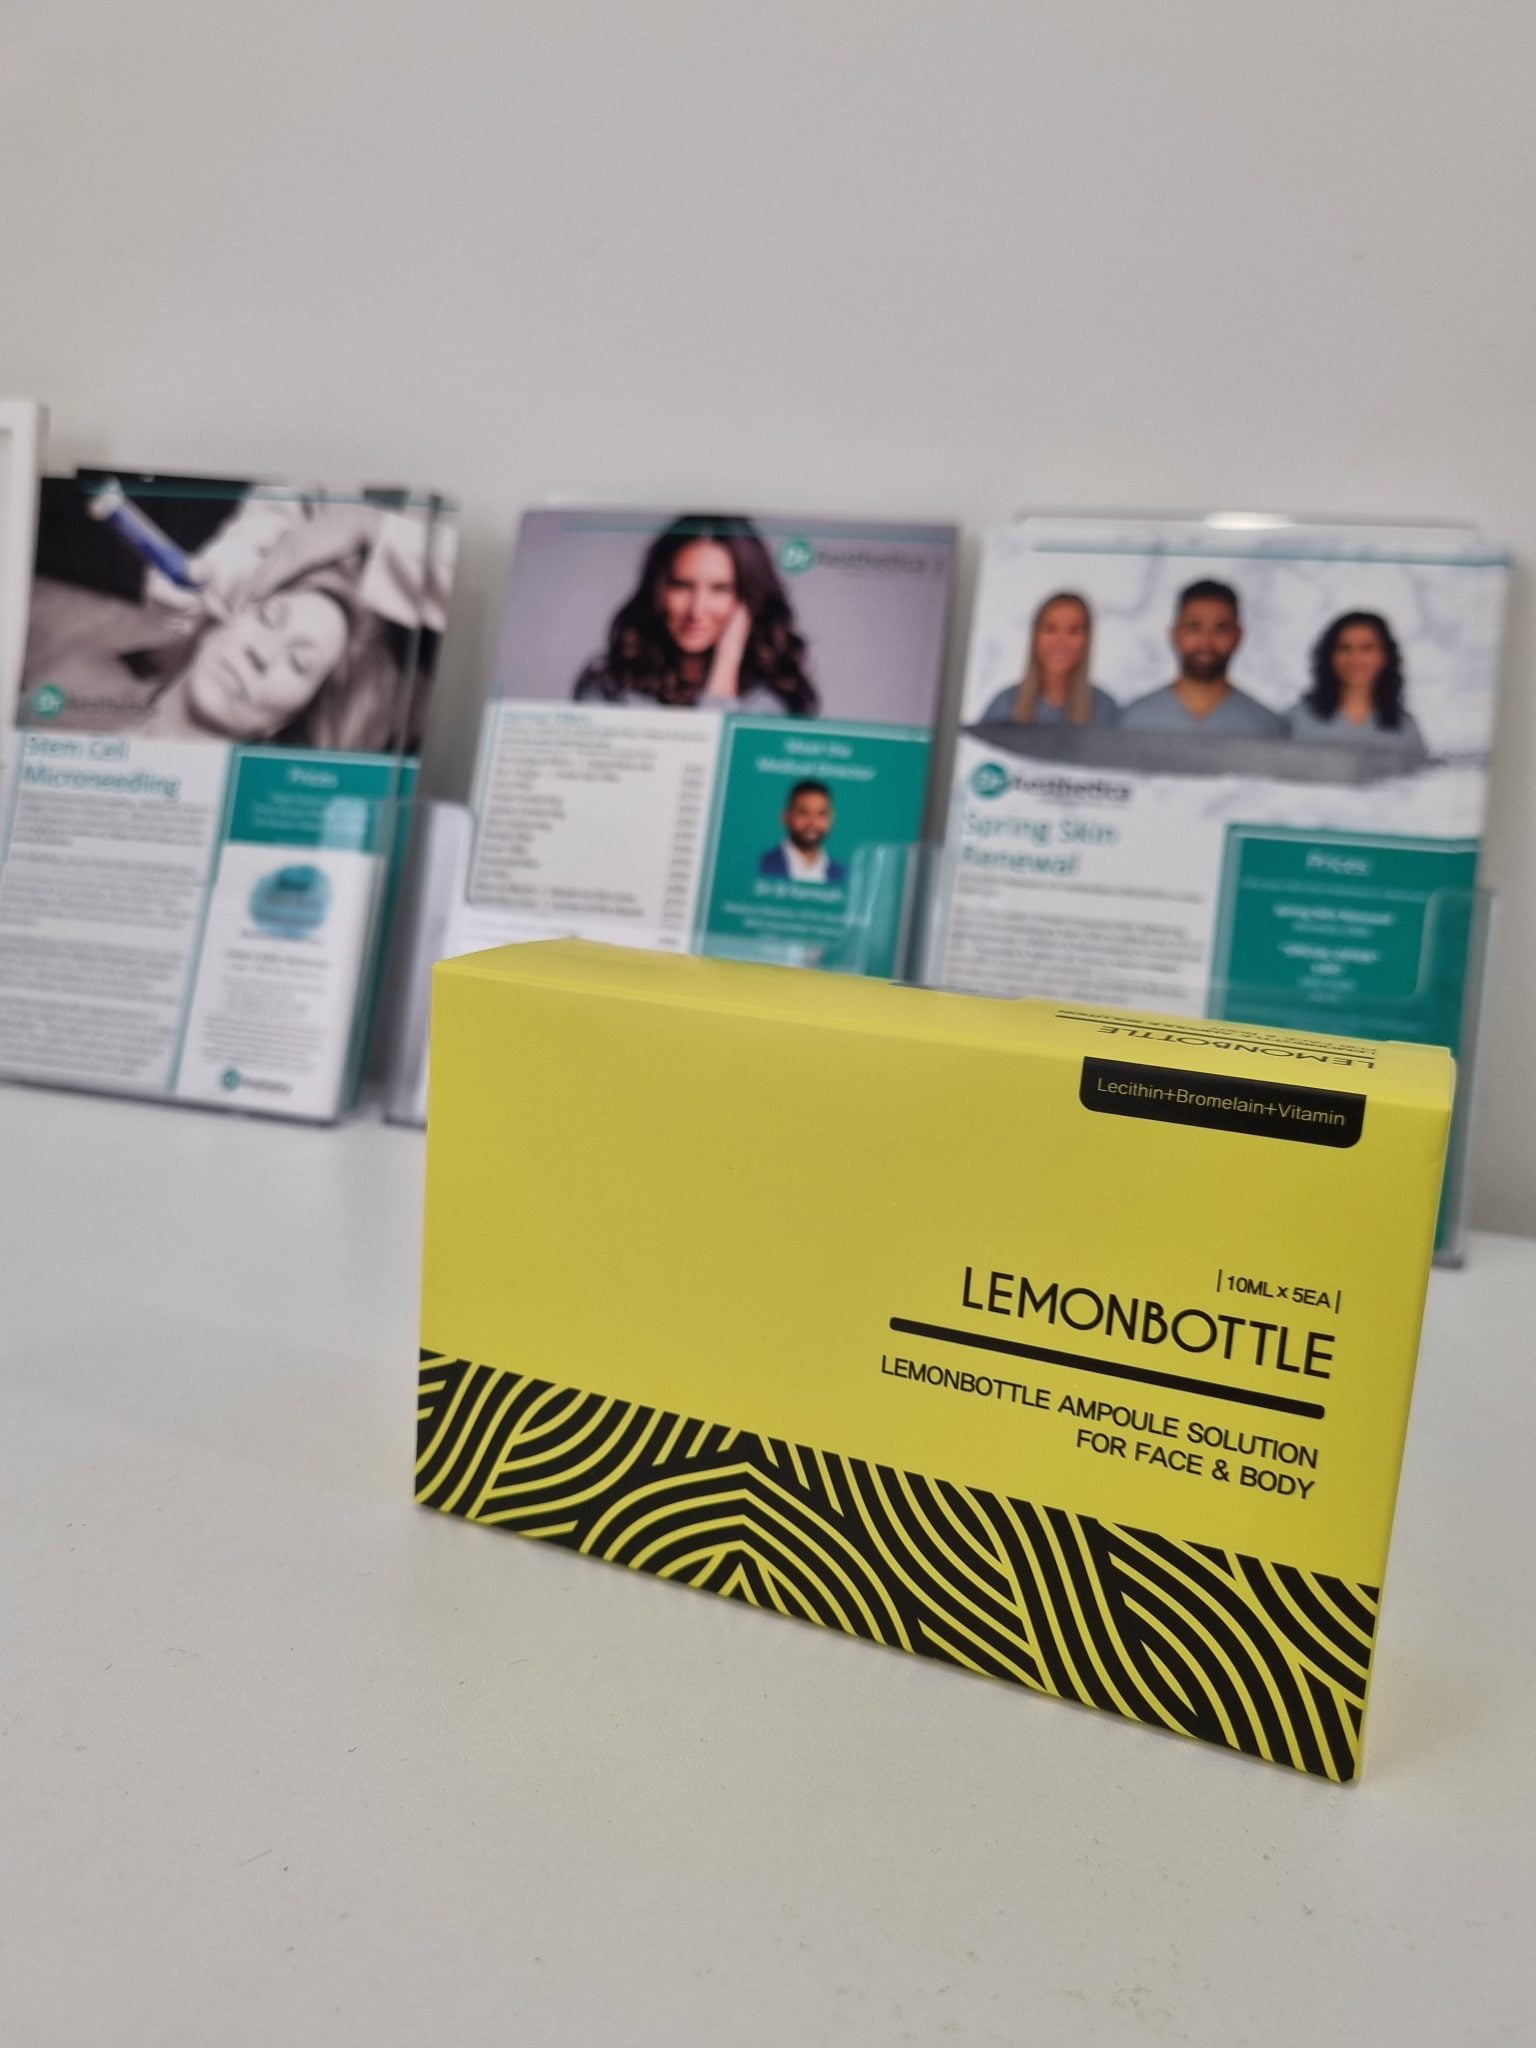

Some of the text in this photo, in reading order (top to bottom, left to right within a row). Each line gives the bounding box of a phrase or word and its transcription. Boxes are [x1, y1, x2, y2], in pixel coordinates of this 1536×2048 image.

[1098, 1025, 1375, 1069] LEMONBOTTLE
[1097, 1078, 1345, 1126] Lecithin+Bromelain+Vitamin
[961, 1266, 1336, 1380] LEMONBOTTLE
[880, 1354, 1319, 1470] LEMONBOTTLE AMPOULE SOLUTION
[1076, 1428, 1316, 1500] FOR FACE & BODY
